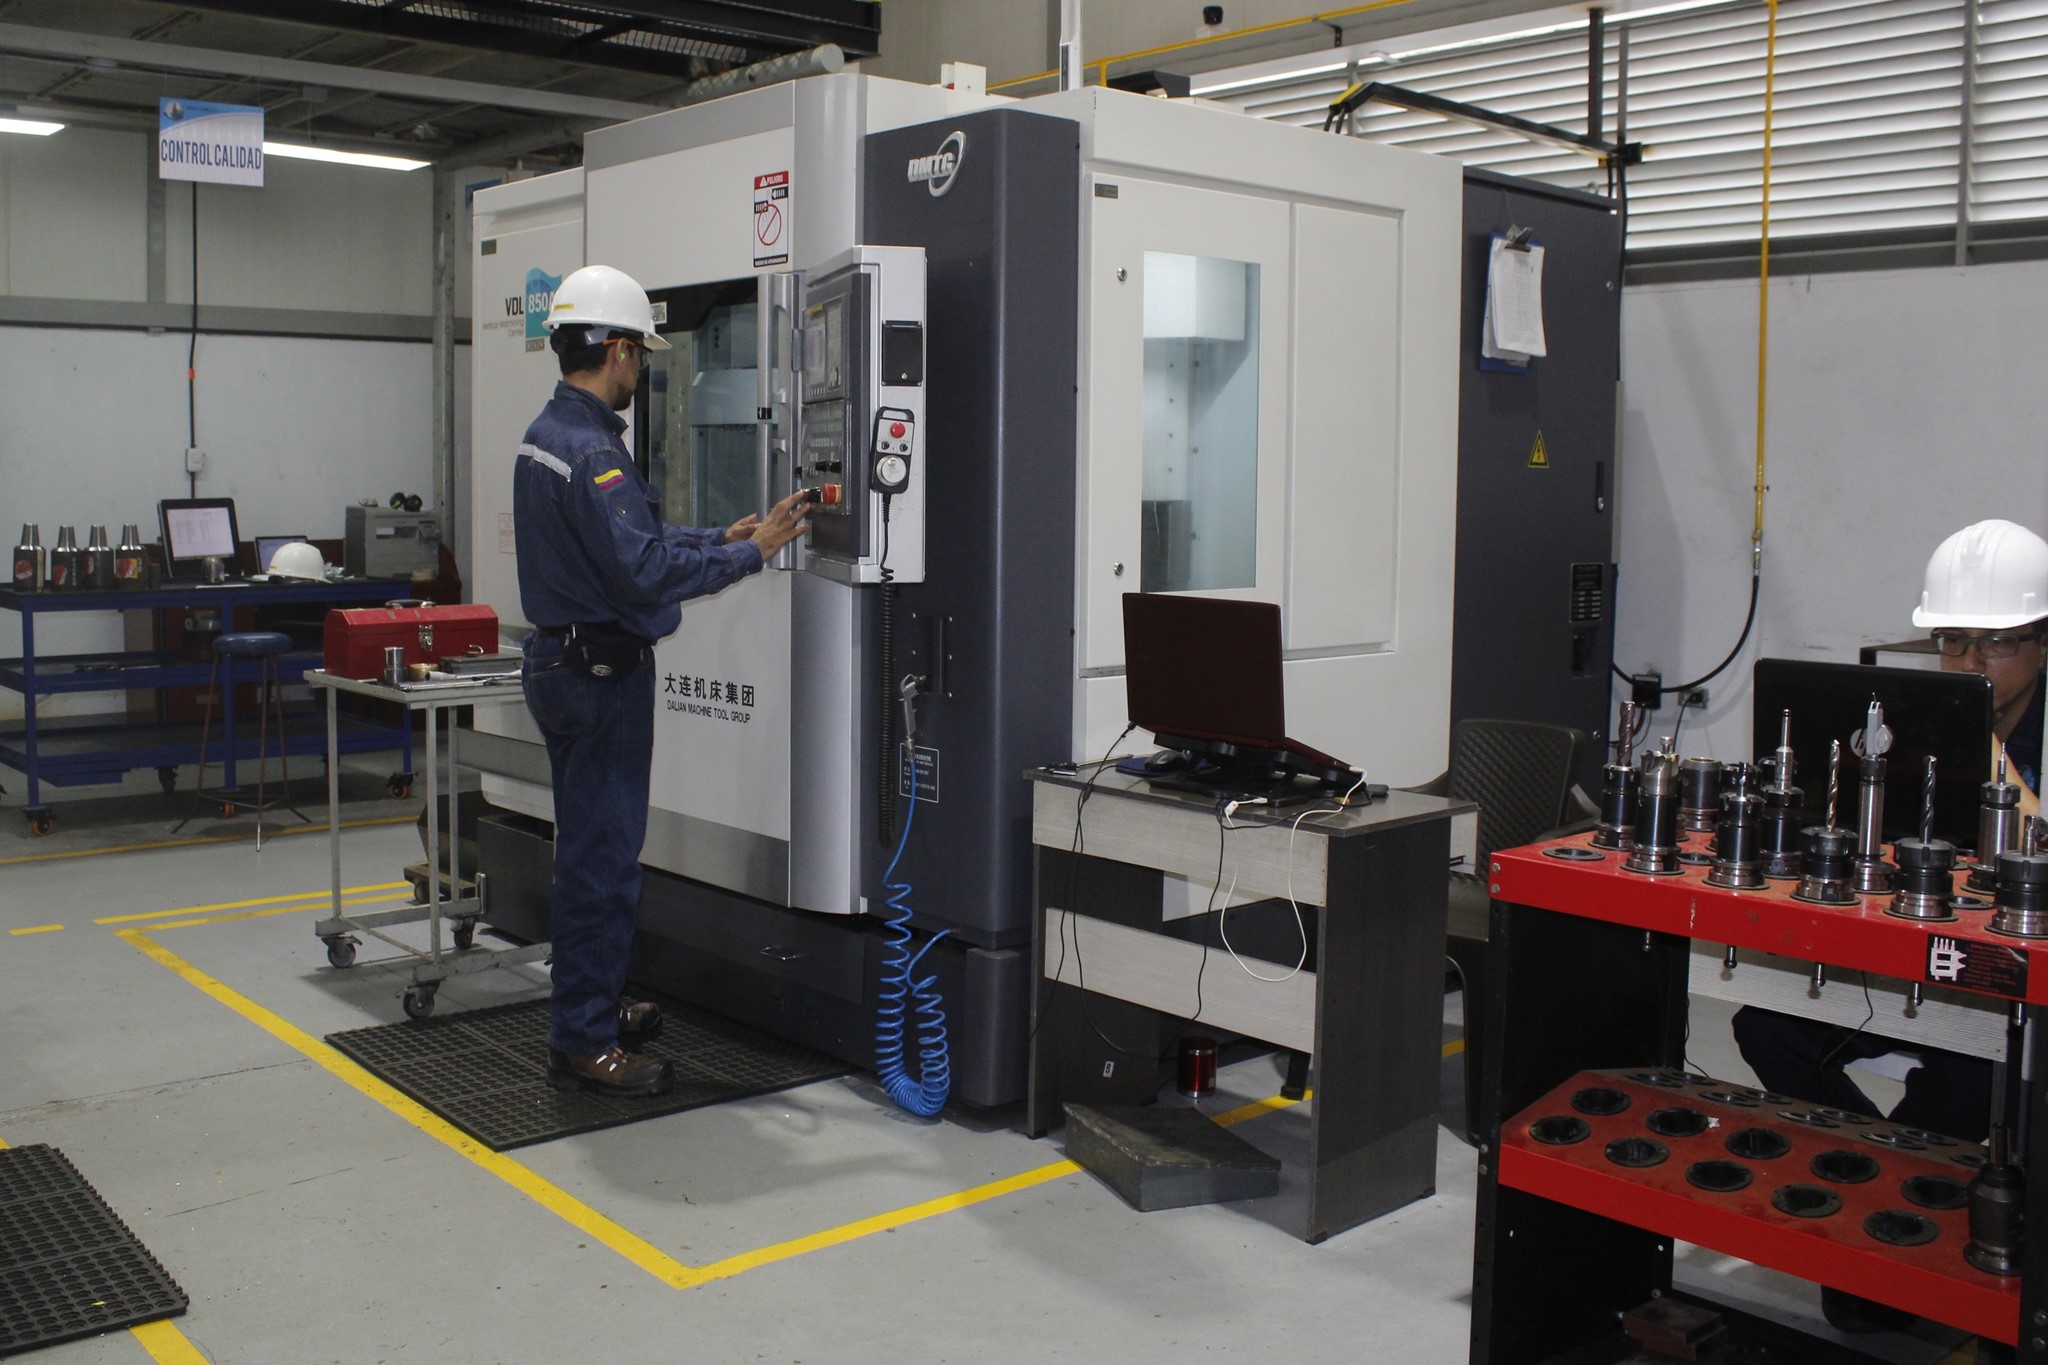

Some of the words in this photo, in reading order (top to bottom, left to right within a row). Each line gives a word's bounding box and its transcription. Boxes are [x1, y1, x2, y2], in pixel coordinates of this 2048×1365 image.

[161, 139, 212, 165] CONTROL
[214, 144, 262, 169] CALIDAD
[908, 152, 956, 182] DMTG
[505, 297, 524, 316] VDL
[665, 673, 754, 707] 大连机床集团
[667, 700, 687, 713] DALIAN
[688, 703, 712, 717] MACHINE
[714, 708, 729, 720] TOOL
[731, 711, 751, 723] GROUP
